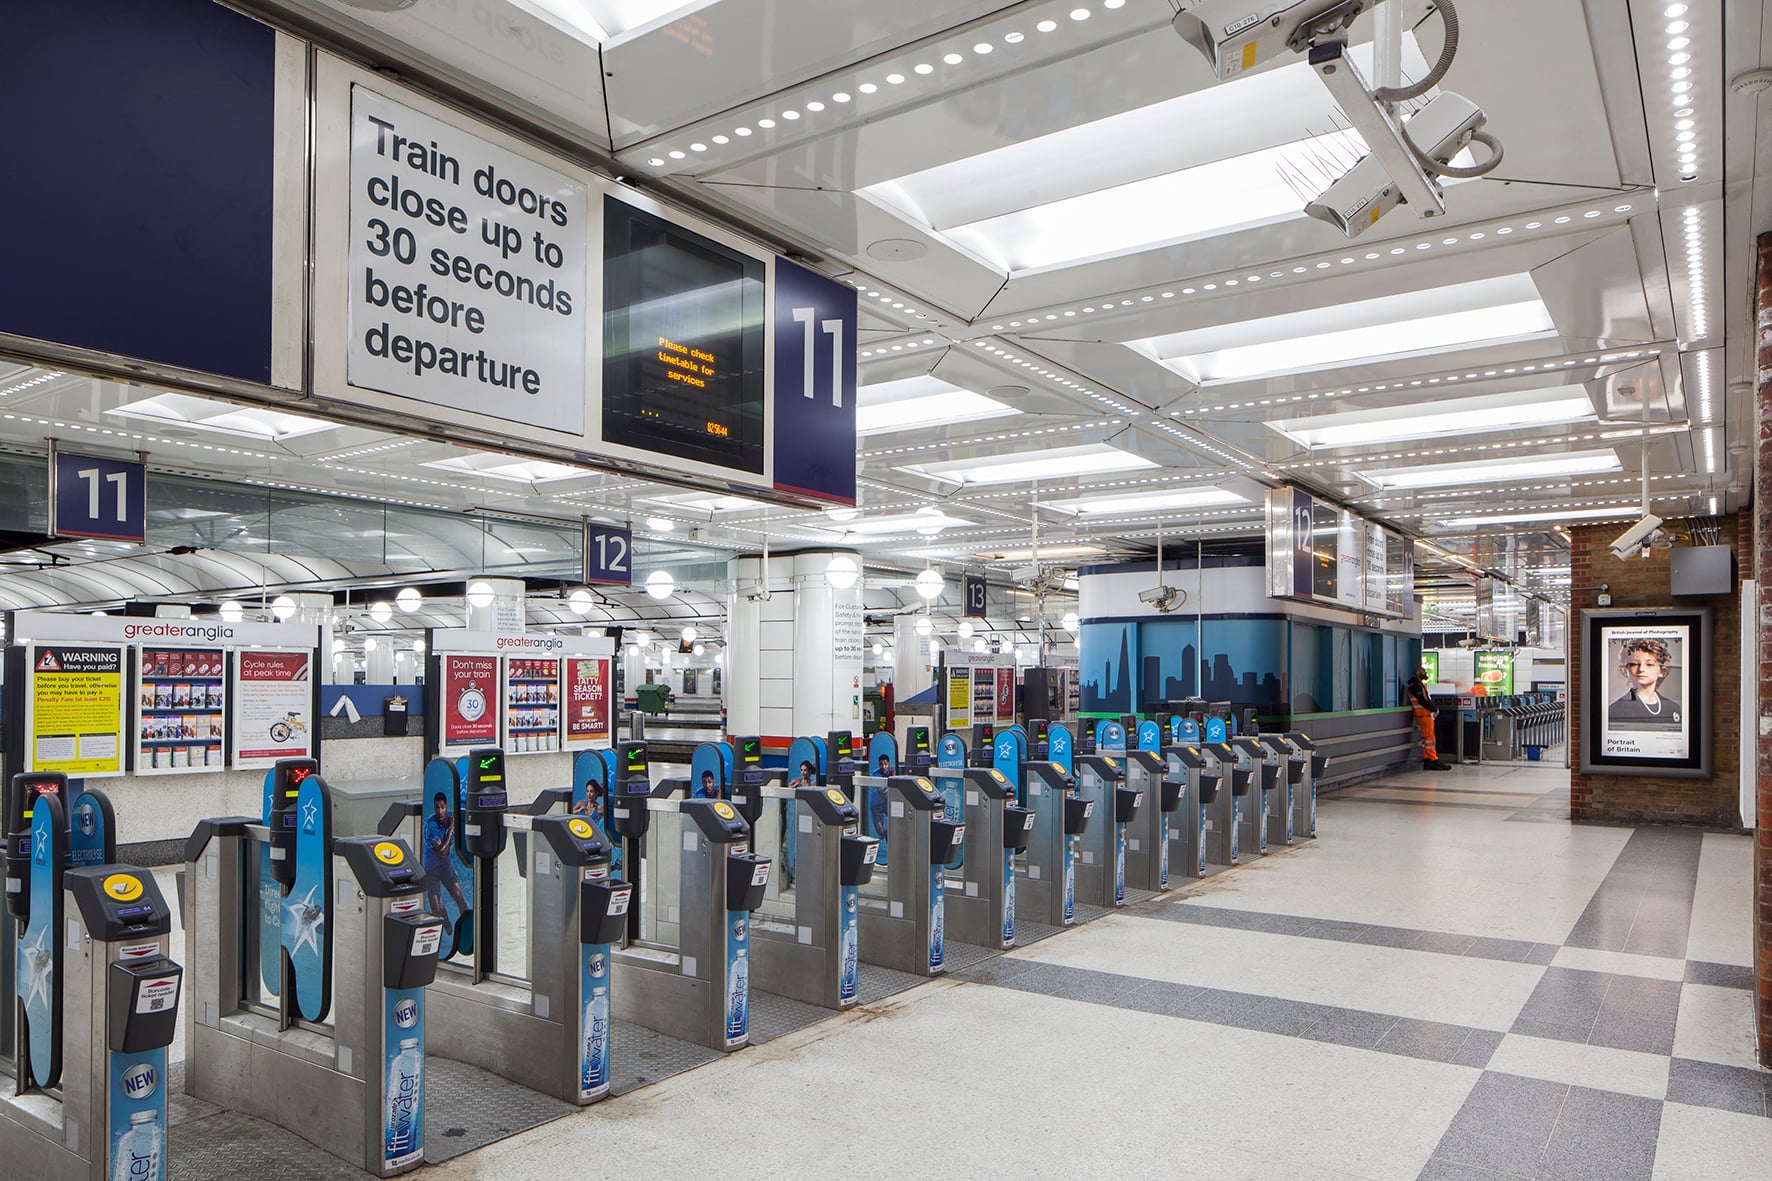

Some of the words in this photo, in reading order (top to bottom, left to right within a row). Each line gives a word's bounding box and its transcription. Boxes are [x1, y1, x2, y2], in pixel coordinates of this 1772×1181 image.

[368, 115, 460, 185] Train
[473, 165, 569, 227] doors
[367, 176, 468, 234] close
[482, 218, 522, 259] up
[534, 233, 563, 269] to
[366, 218, 417, 266] 30
[430, 248, 573, 316] seconds
[365, 267, 486, 335] before
[364, 323, 541, 395] departure
[659, 337, 688, 354] Please
[691, 349, 715, 363] check
[792, 306, 843, 409] 11
[658, 351, 699, 372] timetable
[701, 365, 715, 376] for
[667, 370, 705, 388] services
[78, 468, 126, 522] 11
[1295, 506, 1312, 554] 12
[595, 534, 627, 572] 12
[970, 584, 985, 608] 13
[124, 623, 234, 642] greateranglia
[497, 637, 563, 651] greateranglia
[62, 652, 117, 662] WARNING
[243, 660, 265, 669] Cycle
[266, 661, 284, 669] rules
[452, 660, 474, 669] Don't
[82, 664, 97, 672] you
[98, 664, 117, 672] paid?
[254, 669, 273, 677] peak
[454, 671, 472, 680] your
[473, 670, 490, 678] train
[573, 684, 602, 693] SEASON
[577, 677, 599, 685] TATTY
[466, 699, 479, 709] 30
[573, 692, 603, 701] TICKET?
[581, 722, 604, 730] SMART!
[1607, 738, 1635, 746] Portrait
[589, 958, 606, 974] NEW
[148, 986, 171, 994] Barcode
[396, 1004, 417, 1024] NEW
[125, 1068, 155, 1094] NEW
